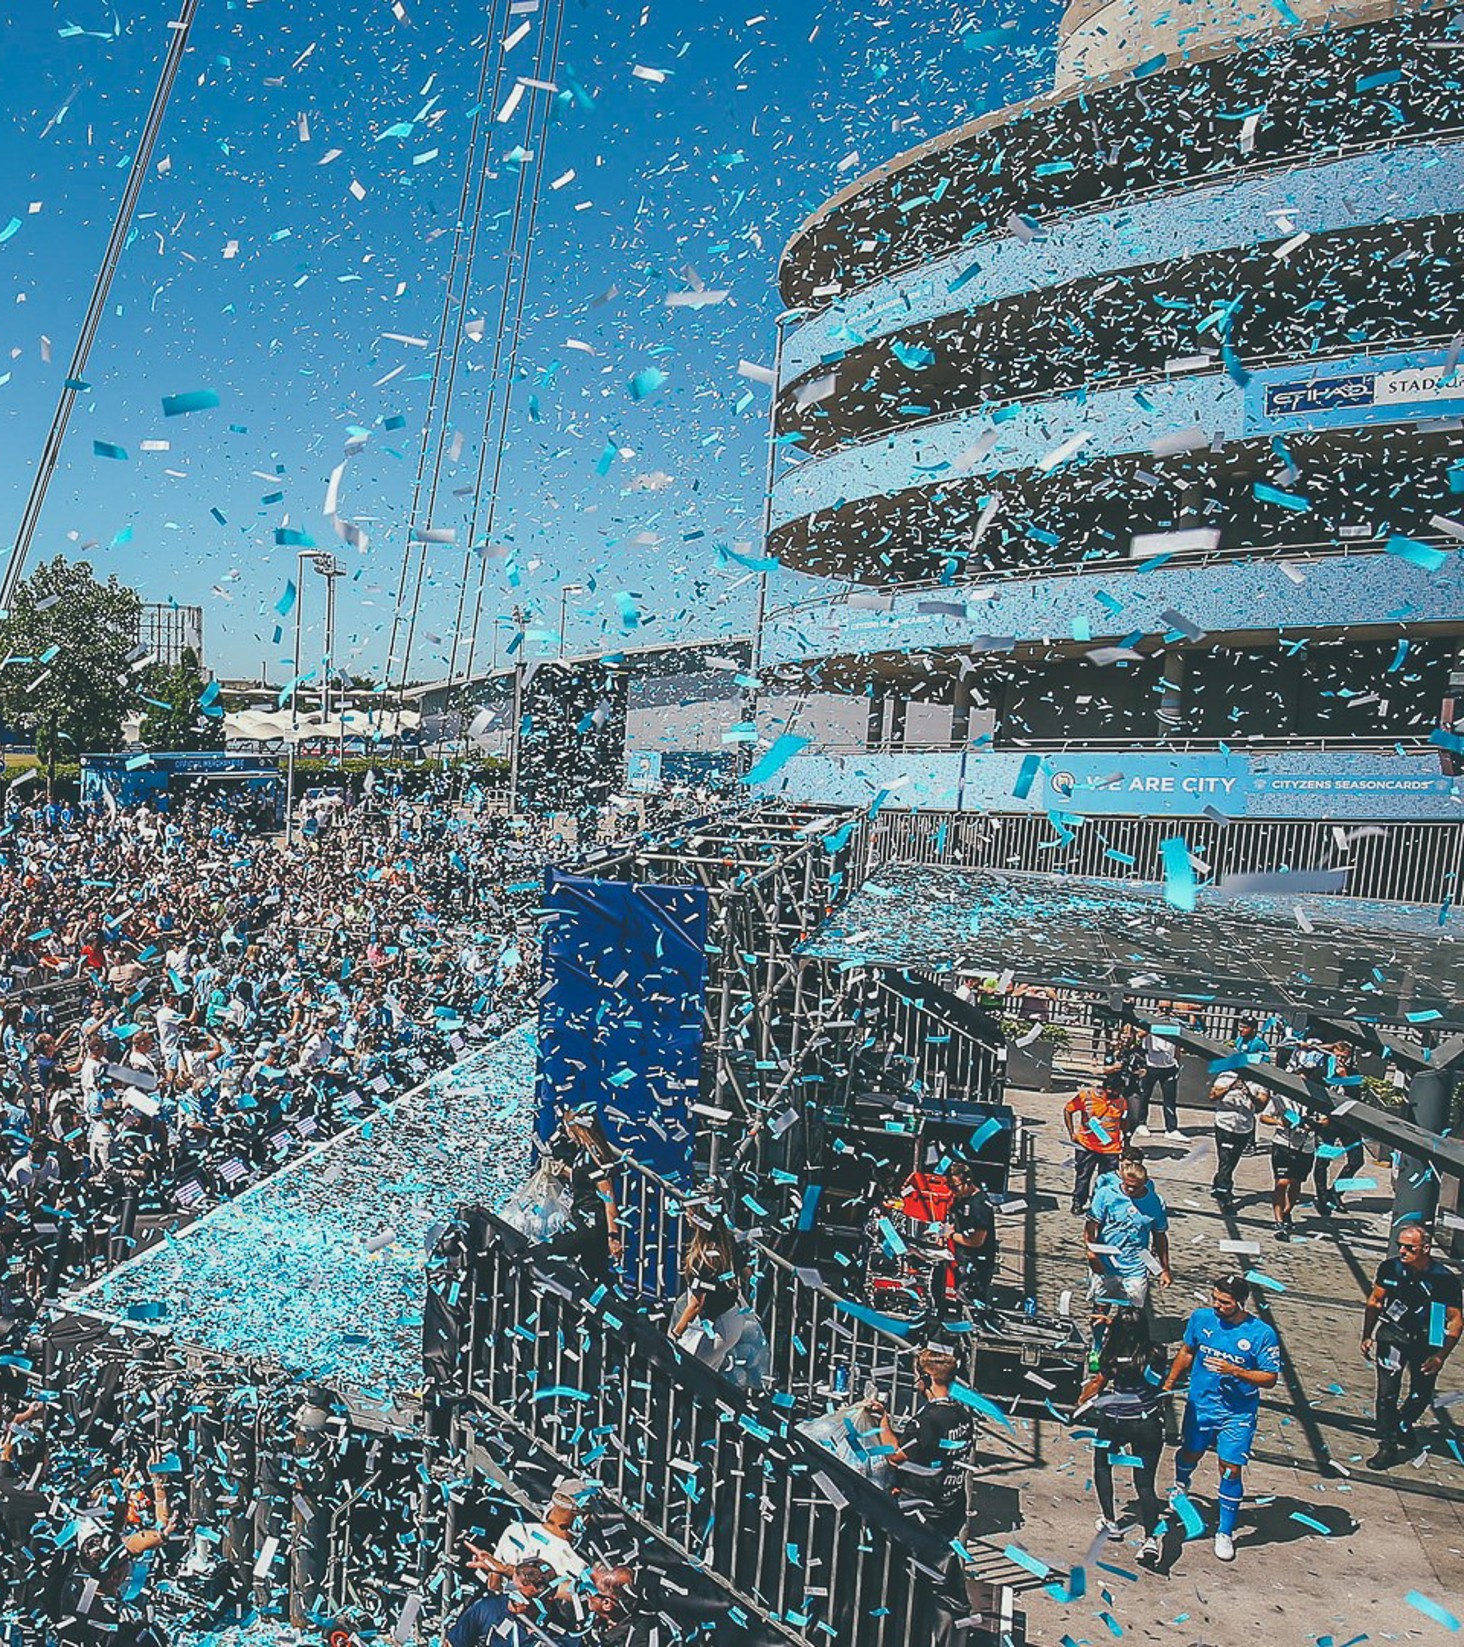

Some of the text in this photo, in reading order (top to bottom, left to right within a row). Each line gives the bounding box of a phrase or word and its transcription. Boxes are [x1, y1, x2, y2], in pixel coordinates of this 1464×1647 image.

[1272, 383, 1370, 411] ETIHAD
[1128, 776, 1176, 793] ARE
[1181, 776, 1238, 793] CITY
[1271, 779, 1431, 790] CITYZENS SEASONCARDS
